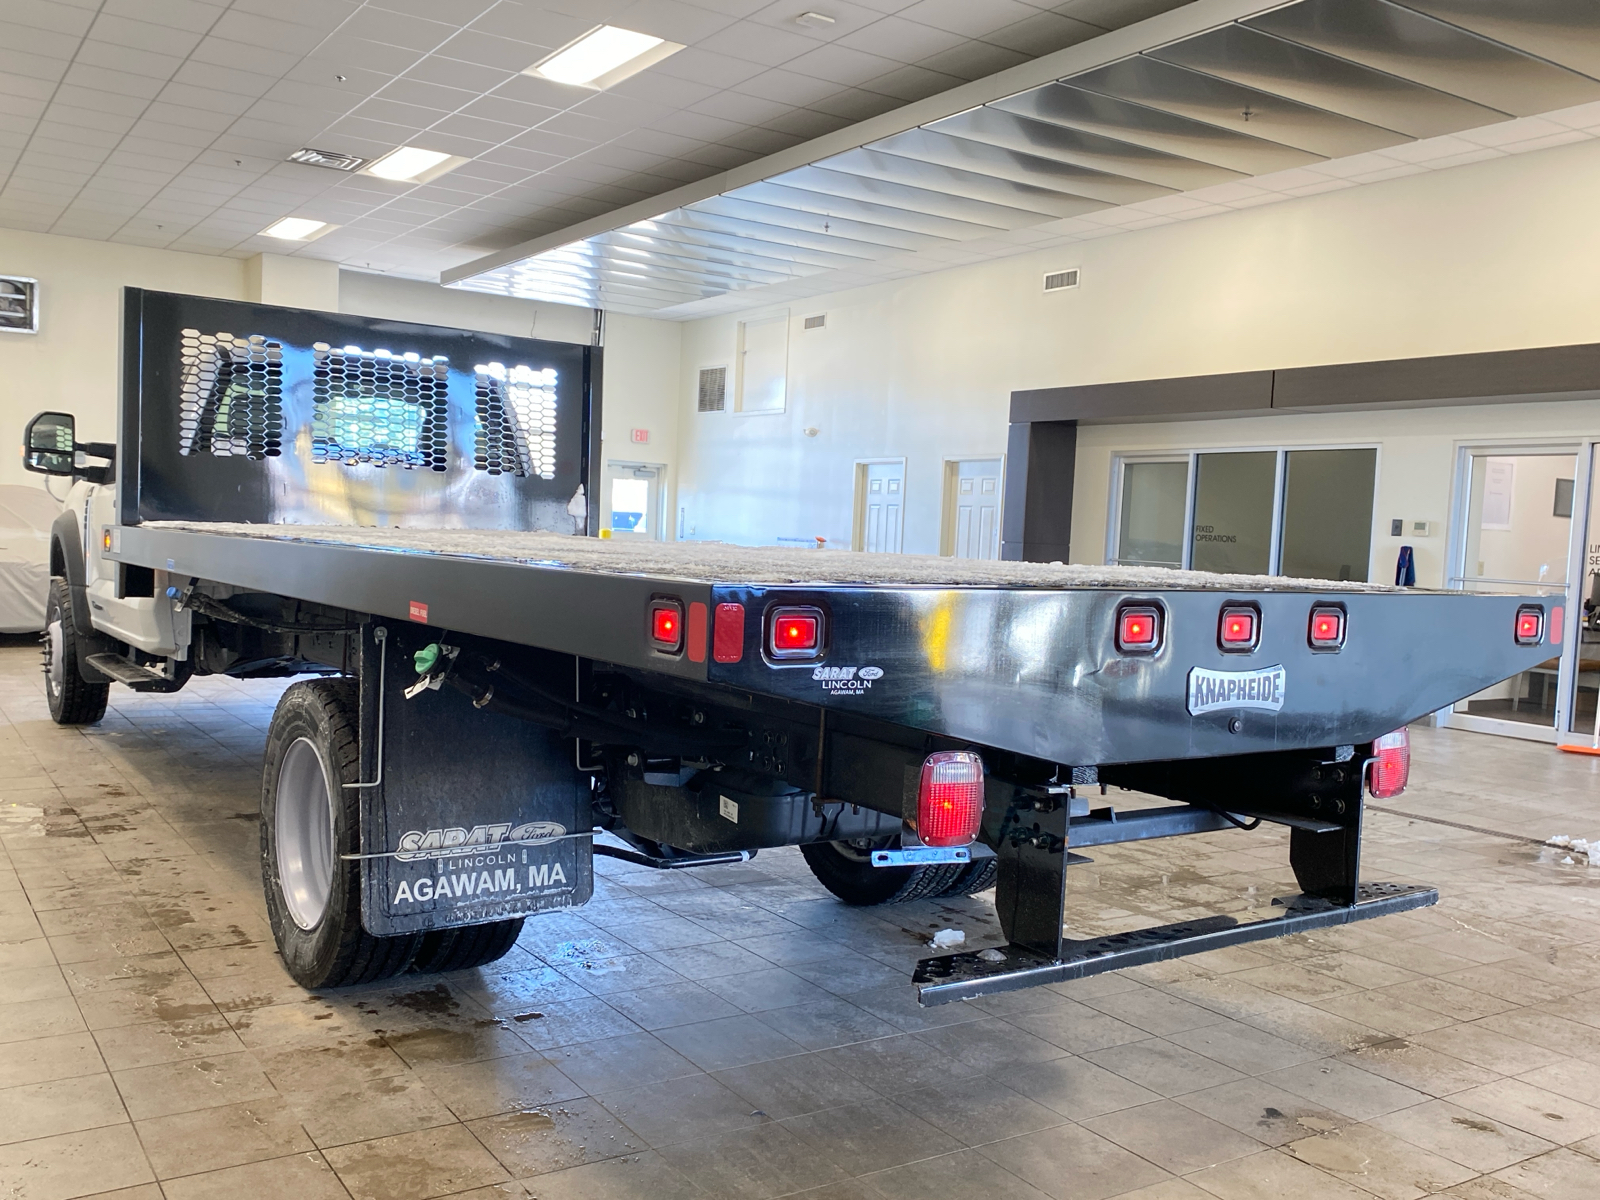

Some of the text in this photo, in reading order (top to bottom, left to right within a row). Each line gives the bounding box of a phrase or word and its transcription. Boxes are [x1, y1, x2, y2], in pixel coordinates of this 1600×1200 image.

[634, 429, 649, 442] EXIT
[1195, 525, 1214, 533] FIXED
[1195, 534, 1237, 543] OPERATIONS
[812, 666, 857, 681] SARAT
[822, 680, 872, 689] LINCOLN
[1194, 672, 1281, 709] KNAPHEIDE
[395, 823, 512, 862] SARAT
[449, 853, 517, 870] LINCOLN
[393, 862, 567, 905] AGAWAM, MA
